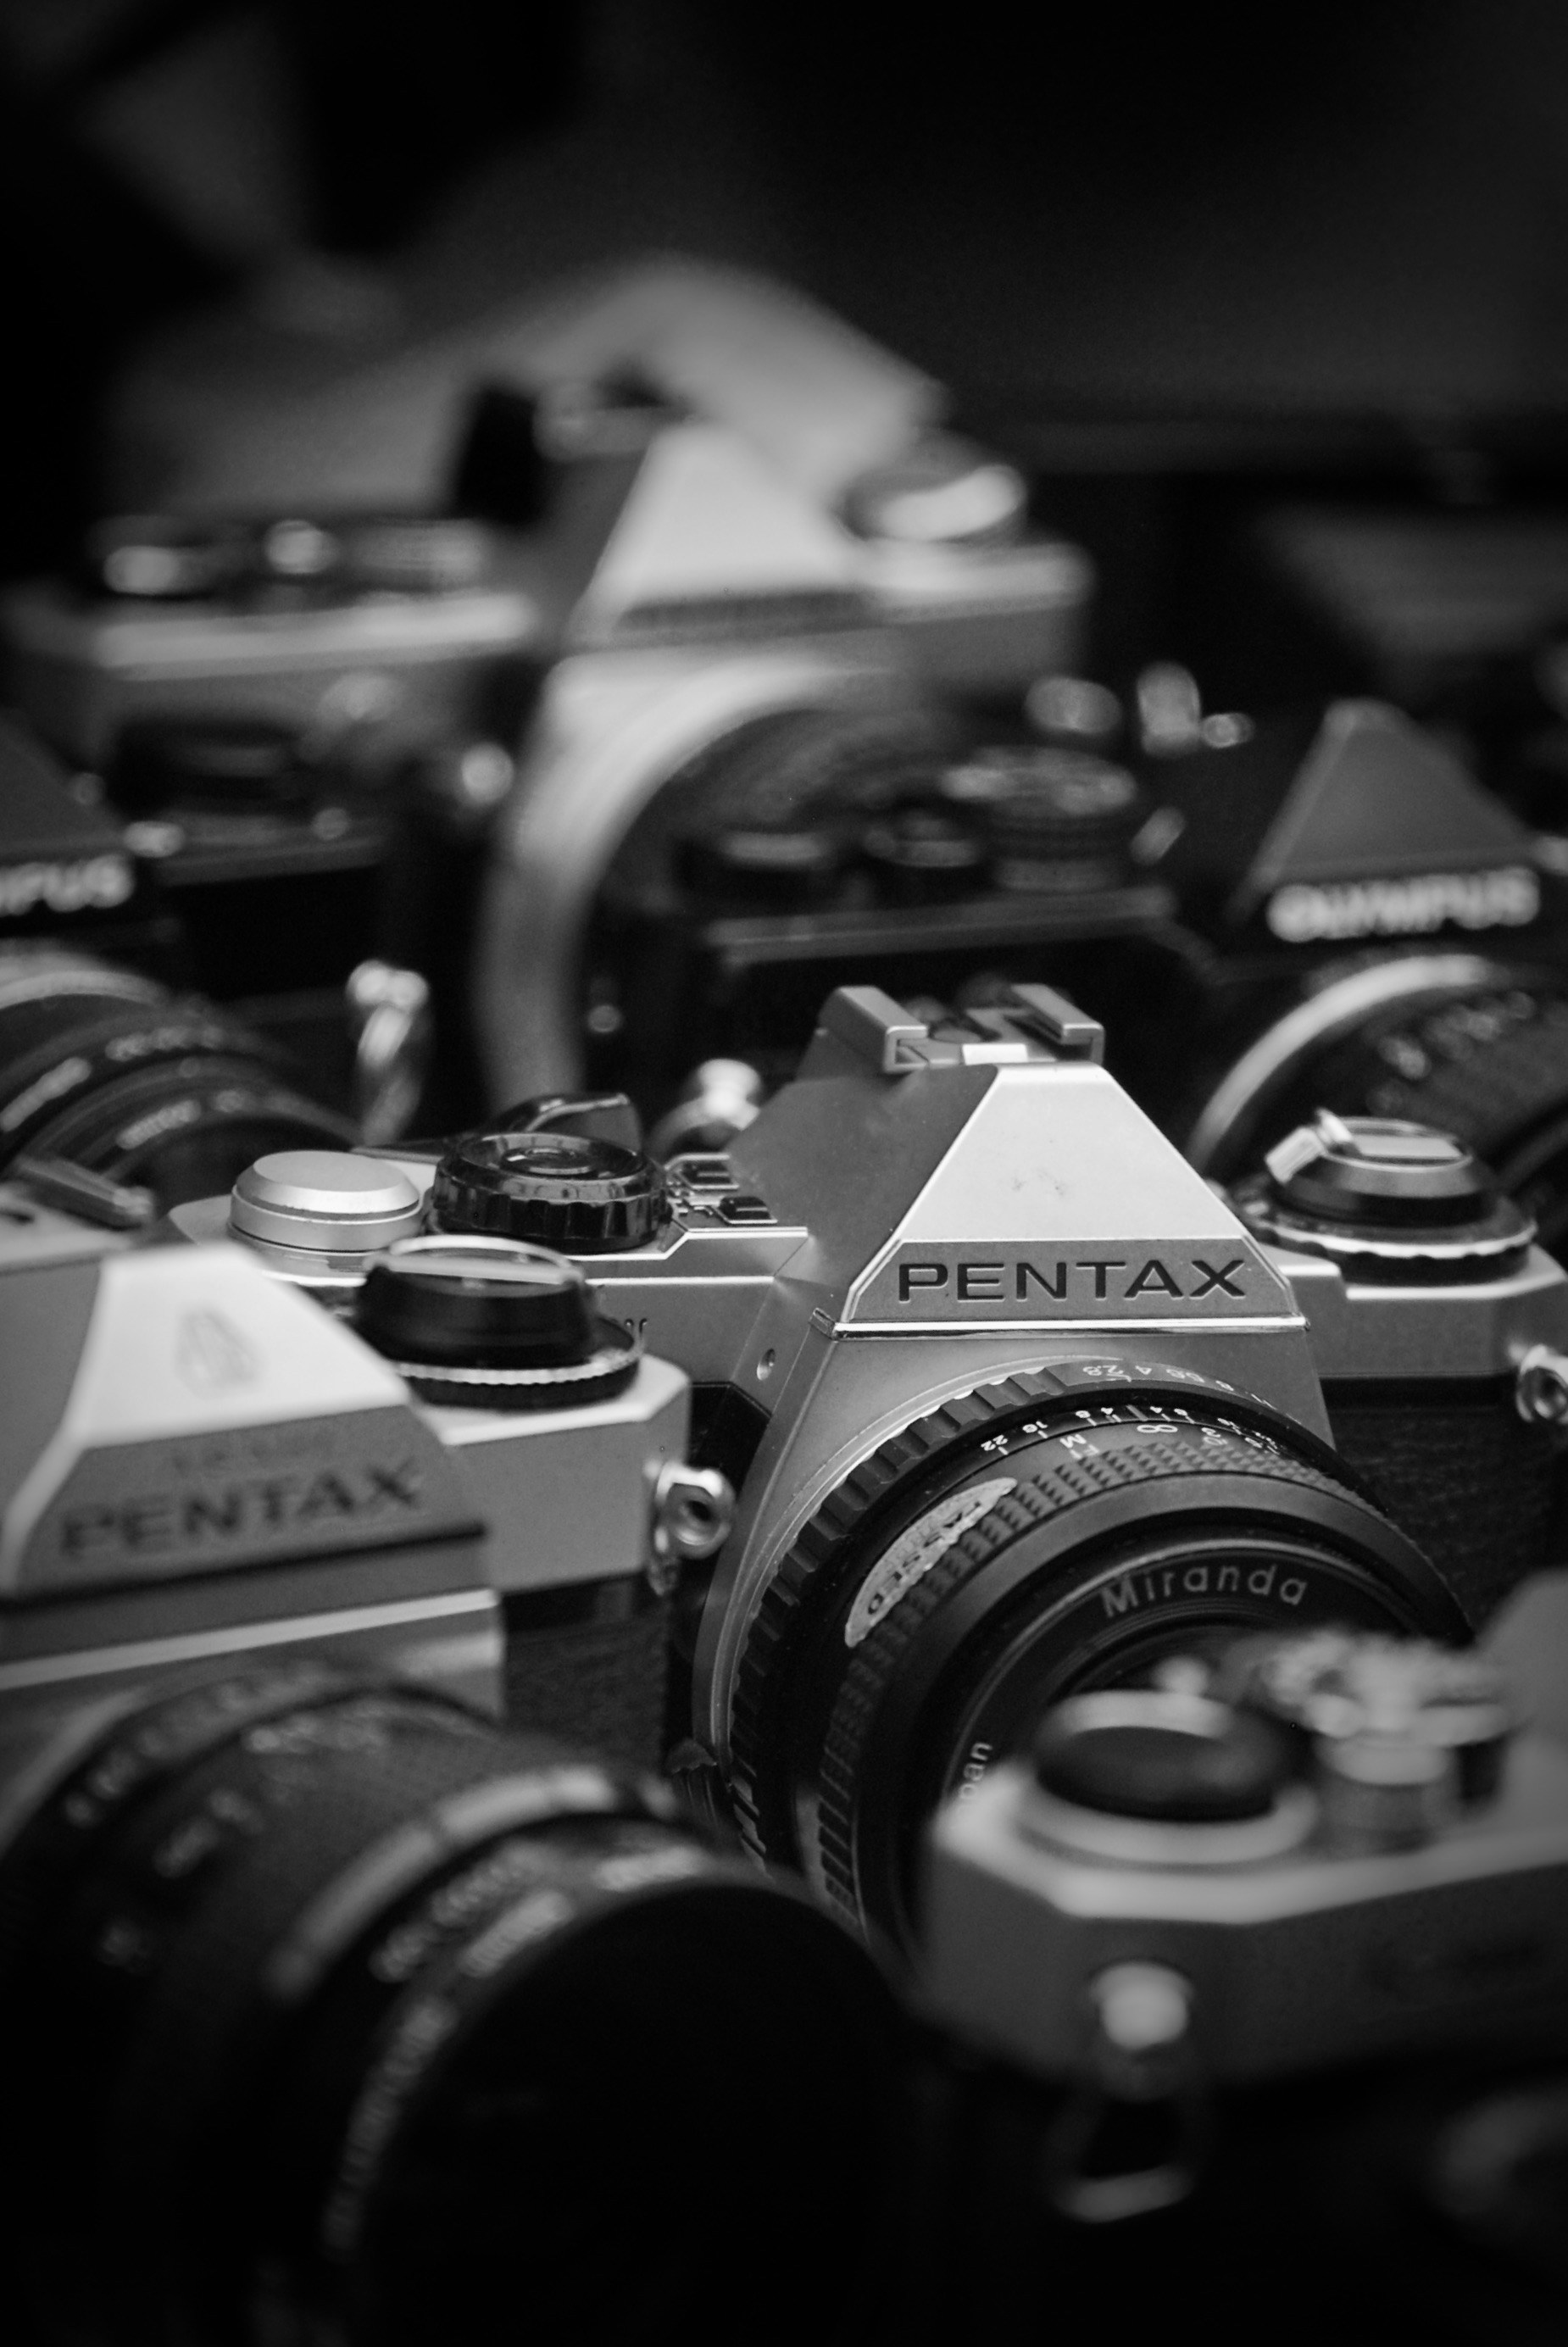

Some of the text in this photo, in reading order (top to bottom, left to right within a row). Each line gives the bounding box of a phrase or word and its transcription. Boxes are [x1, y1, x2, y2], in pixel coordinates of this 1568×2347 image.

[898, 1259, 1246, 1303] PENTAX
[981, 1435, 1008, 1451] 22
[58, 1460, 422, 1561] PENTAX
[1101, 1564, 1308, 1618] Miranda
